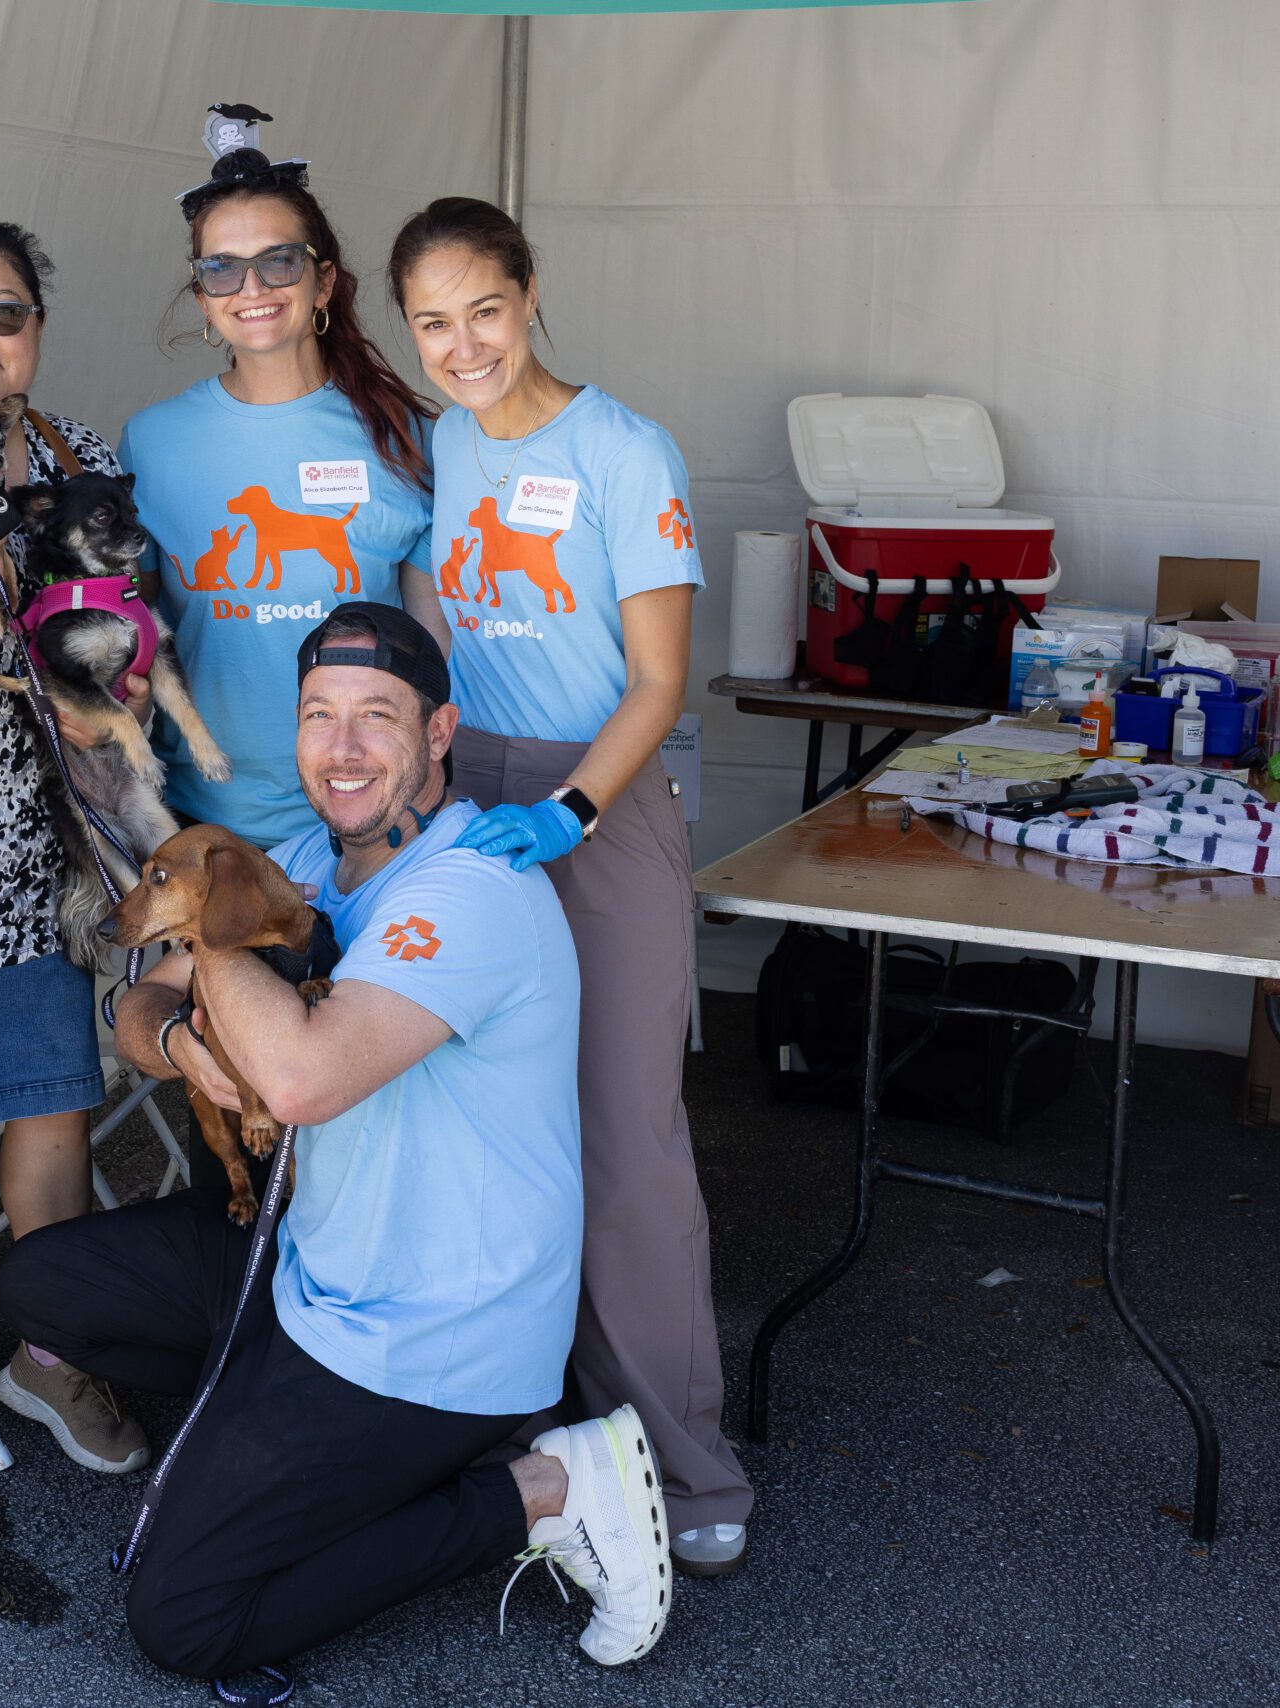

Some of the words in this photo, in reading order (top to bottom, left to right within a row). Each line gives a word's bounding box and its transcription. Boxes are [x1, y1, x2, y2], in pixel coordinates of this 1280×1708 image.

[323, 466, 359, 475] Banfield
[320, 485, 348, 493] Elizabeth
[537, 484, 570, 495] Banfield
[544, 493, 569, 502] HOSPITAL
[534, 506, 564, 516] Gonzalez
[211, 599, 251, 620] Do
[255, 599, 330, 625] good.
[483, 619, 544, 640] good.
[43, 712, 58, 742] SOCIETY
[667, 733, 697, 744] eshpet
[675, 743, 696, 751] FOOD
[98, 861, 115, 891] HUMANE
[128, 946, 140, 985] AMERICAN
[282, 1123, 294, 1148] RICAN
[274, 1147, 289, 1182] HUMANE
[265, 1181, 281, 1216] SOCIETY
[250, 1235, 265, 1276] AMERICAN
[186, 1384, 211, 1425] AMERICAN
[168, 1422, 190, 1456] HUMANE
[152, 1453, 172, 1488] SOCIETY
[130, 1503, 151, 1546] AMERICAN
